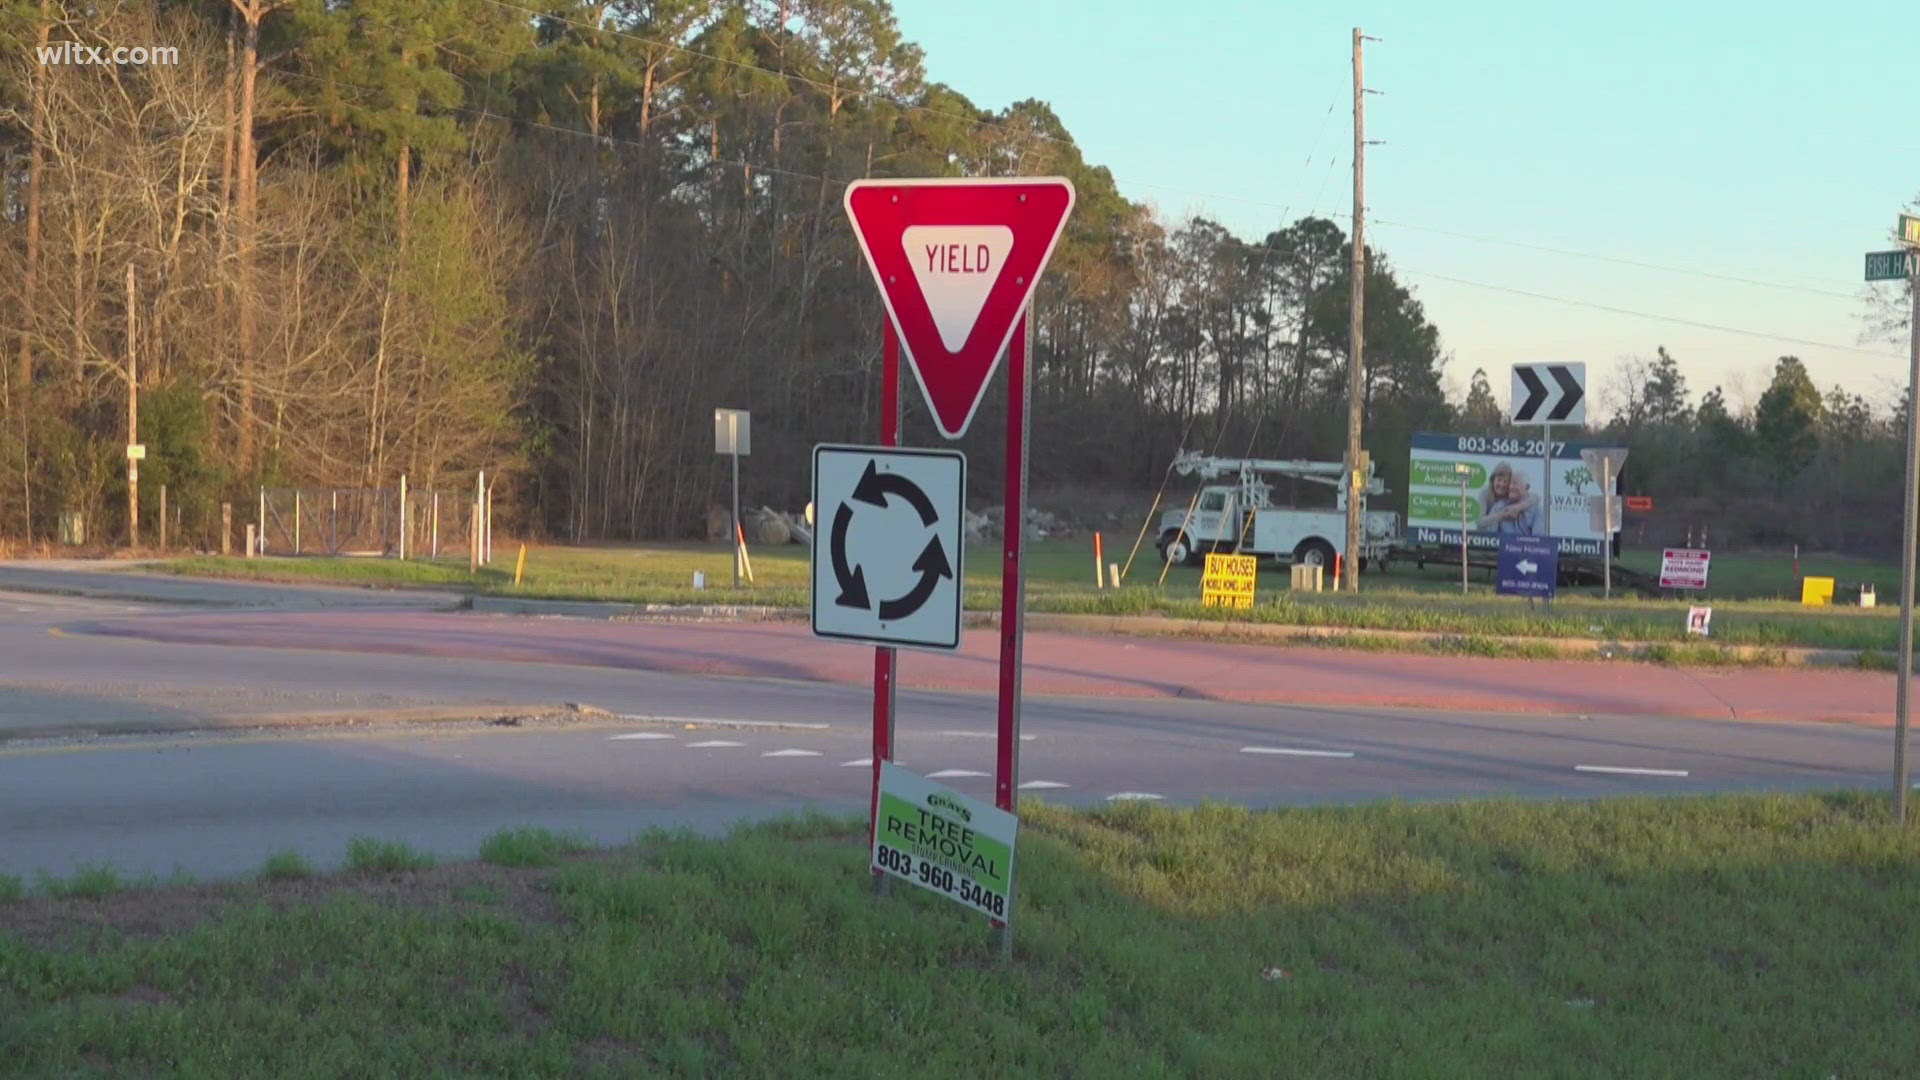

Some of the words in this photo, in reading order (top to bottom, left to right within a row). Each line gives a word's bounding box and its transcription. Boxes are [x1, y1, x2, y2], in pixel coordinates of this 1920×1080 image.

[925, 244, 989, 273] YIELD
[1867, 254, 1890, 277] FISH
[1418, 528, 1437, 542] No
[1558, 538, 1600, 555] blem!
[1211, 556, 1226, 576] BUY
[1226, 557, 1255, 578] HOUSES
[917, 807, 975, 850] TREE
[887, 815, 1000, 880] REMOVAL
[877, 845, 1005, 917] 803-960-5448
